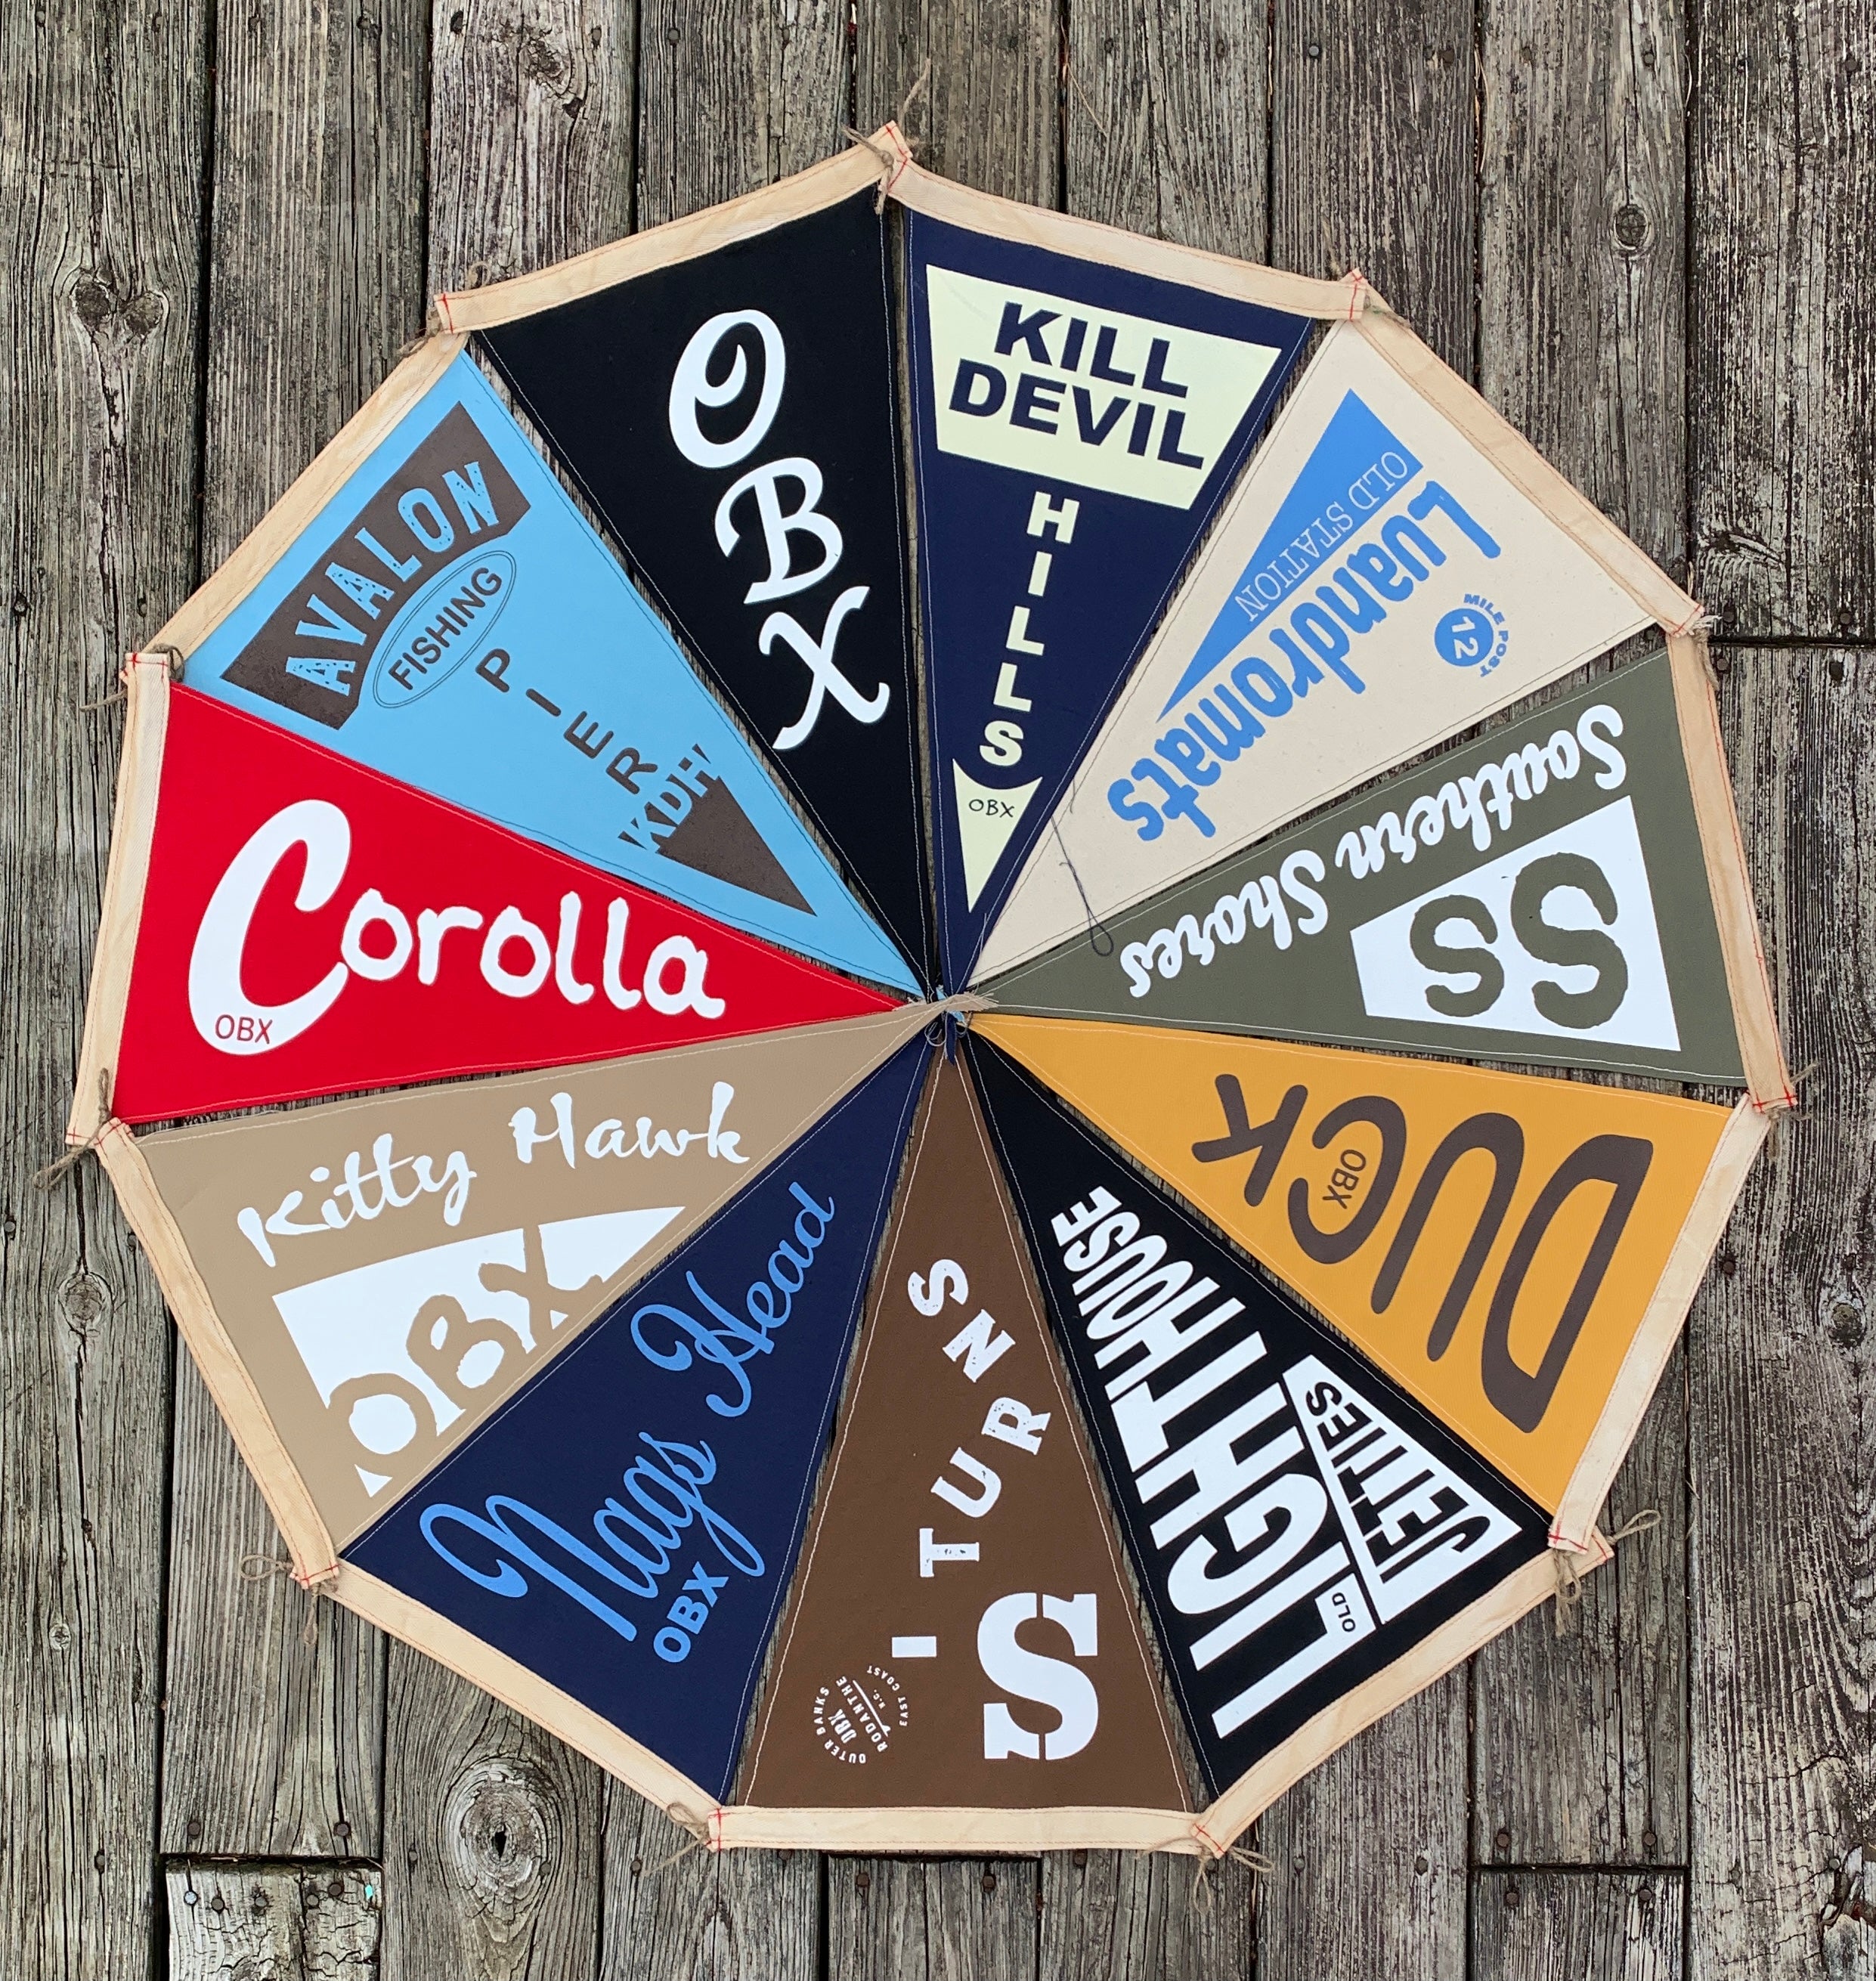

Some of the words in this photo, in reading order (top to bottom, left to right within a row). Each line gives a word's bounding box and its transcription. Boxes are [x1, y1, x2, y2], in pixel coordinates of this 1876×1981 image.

[993, 302, 1188, 400] KILL
[949, 358, 1205, 470] DEVIL
[669, 309, 890, 751] OBX
[1348, 451, 1408, 510] OLD
[286, 461, 499, 696] AVALON
[1234, 500, 1353, 622] STATION
[1463, 593, 1505, 625] MILE
[388, 567, 502, 690] FISHING
[980, 491, 1079, 766] HILLS
[1107, 480, 1500, 840] Luandromats
[1451, 616, 1478, 659] 12
[1480, 630, 1509, 677] POST
[475, 648, 658, 795] PIER
[624, 748, 718, 847] KDH
[968, 798, 1015, 819] OBX
[1336, 704, 1627, 880] Southern
[188, 799, 726, 1055] Corolla
[1119, 849, 1329, 999] Shores
[215, 1014, 273, 1045] OBX
[237, 1133, 477, 1268] Kitty
[509, 1081, 751, 1169] Hawk
[1322, 1149, 1367, 1210] OBX
[1190, 1073, 1655, 1435] DUCK
[330, 1226, 606, 1486] OBX
[419, 1432, 765, 1643] Nags
[631, 1182, 834, 1418] Head
[1051, 1185, 1377, 1740] LIGHTHOUSE
[1305, 1381, 1491, 1585] JETTIES
[653, 1561, 731, 1664] OBX
[1331, 1592, 1357, 1633] OLD
[813, 1686, 830, 1736] BANKS
[835, 1676, 888, 1753] RODANTHE
[866, 1665, 900, 1692] COAST
[897, 1696, 909, 1727] EAST
[824, 1739, 867, 1764] OUTER
